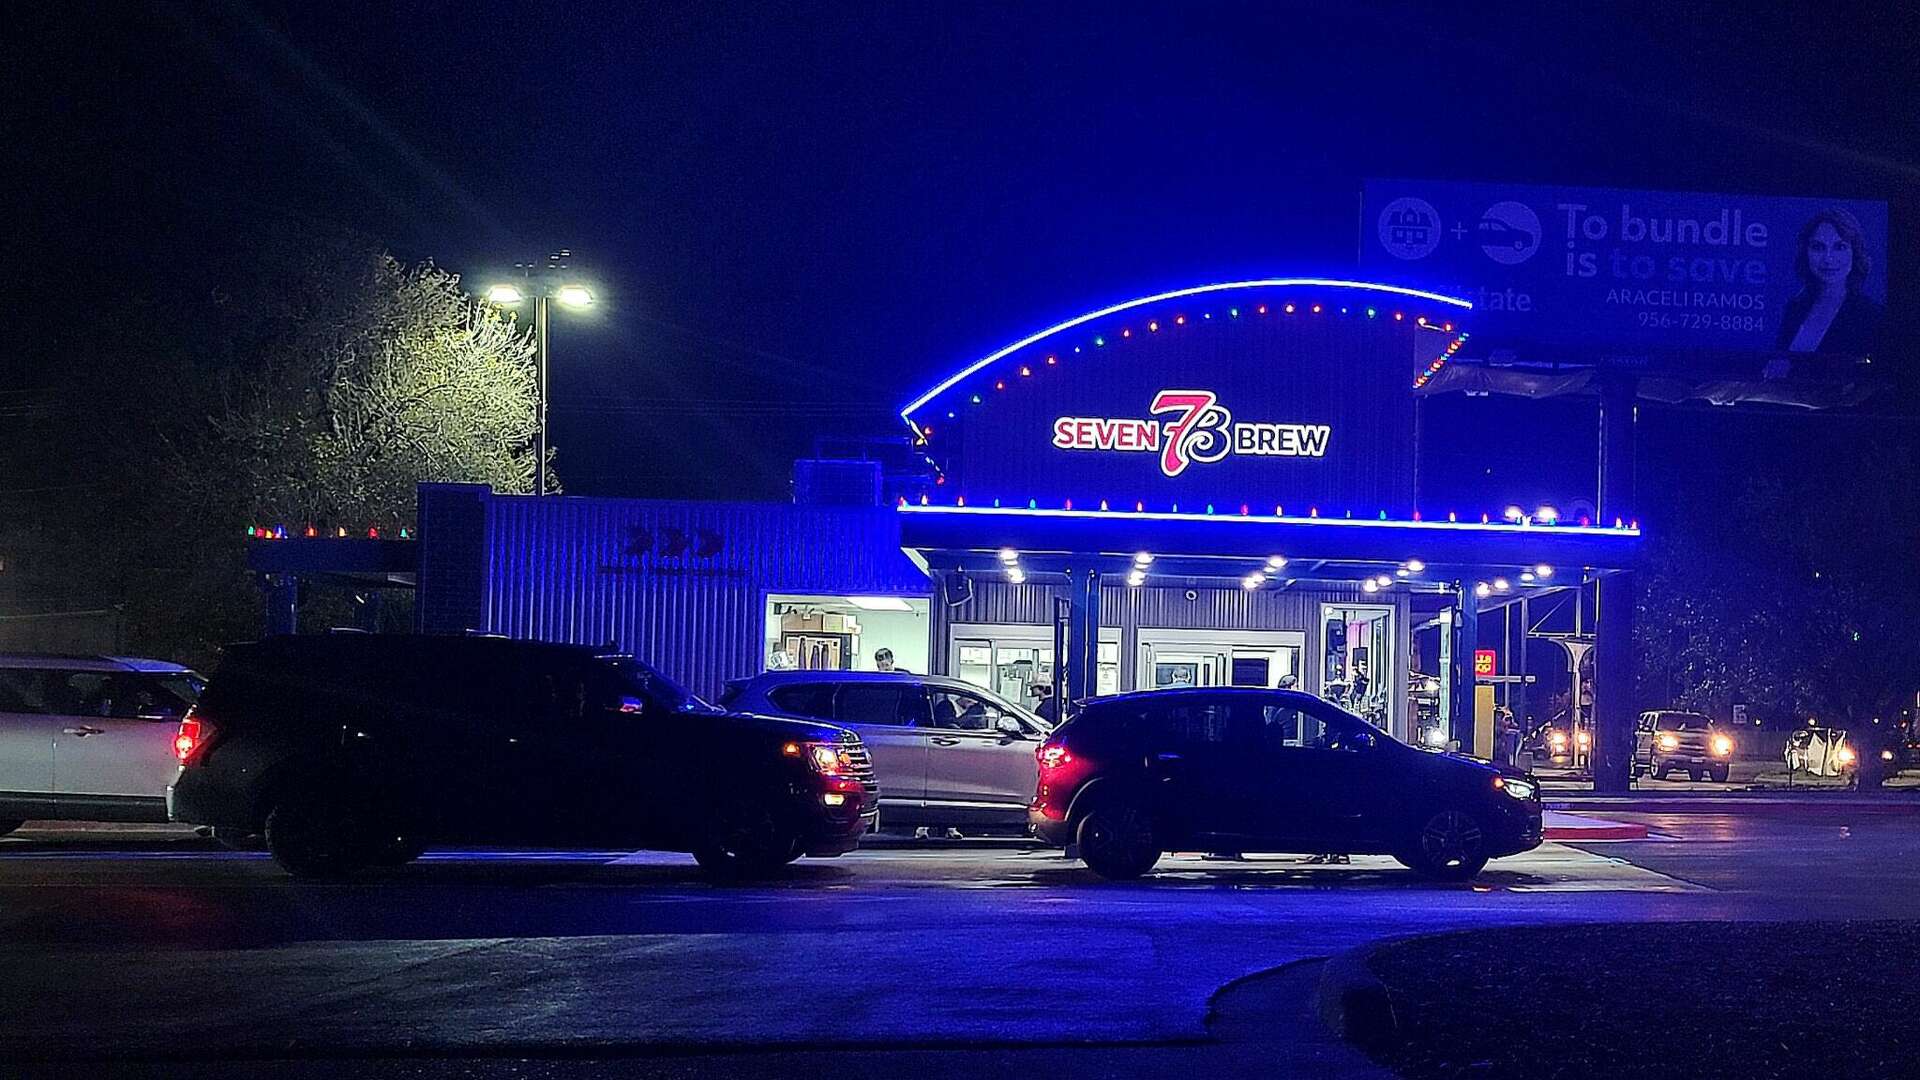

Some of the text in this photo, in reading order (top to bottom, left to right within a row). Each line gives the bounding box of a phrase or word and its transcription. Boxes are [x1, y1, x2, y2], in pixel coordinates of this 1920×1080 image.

[1557, 203, 1768, 246] To bundle
[1565, 241, 1767, 284] is to save
[1606, 288, 1765, 311] ARACELI RAMOS
[1638, 311, 1764, 332] 956-729-8884
[1052, 417, 1159, 450] SEVEN
[1234, 423, 1331, 456] BREW
